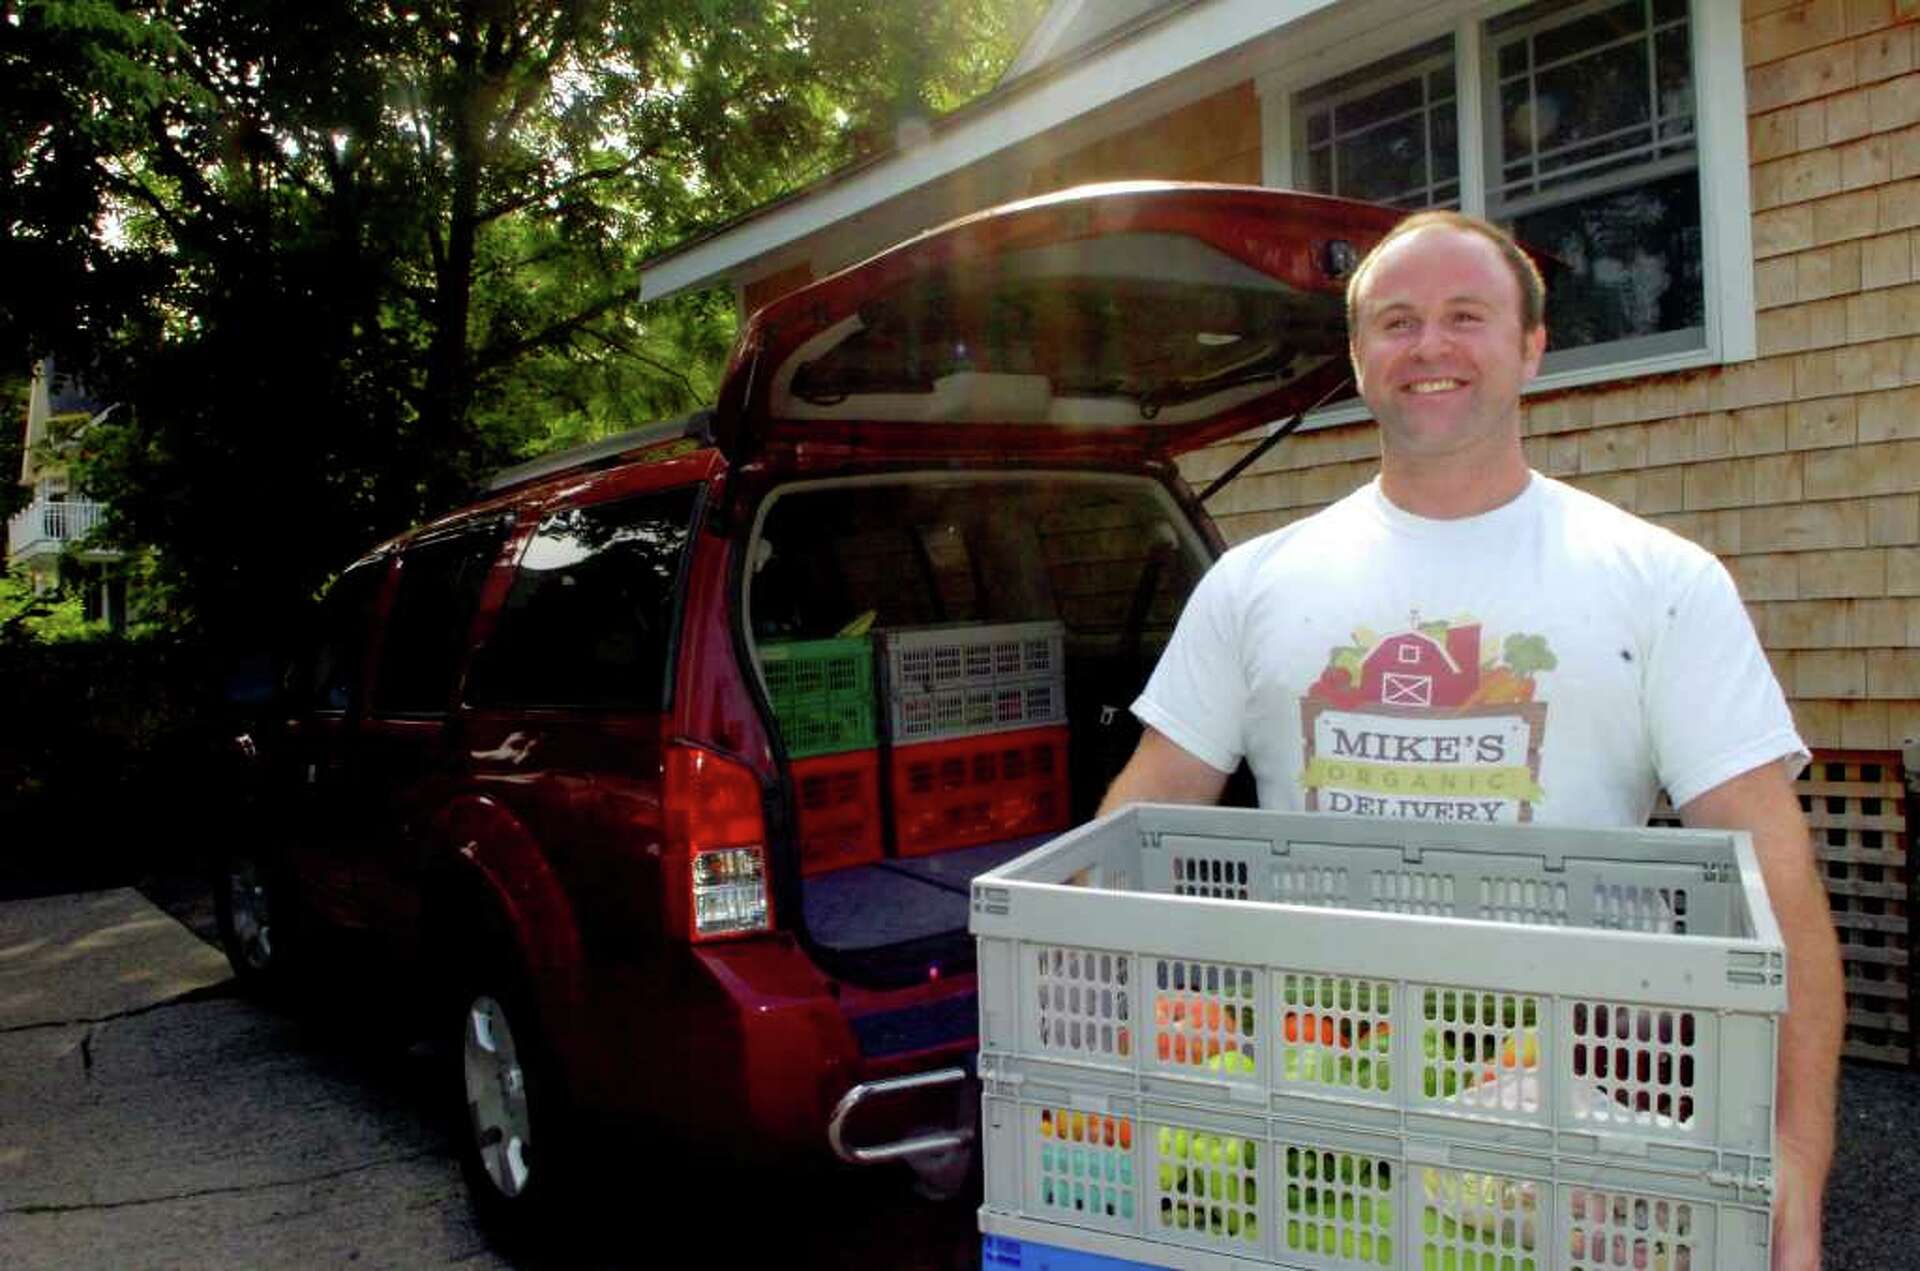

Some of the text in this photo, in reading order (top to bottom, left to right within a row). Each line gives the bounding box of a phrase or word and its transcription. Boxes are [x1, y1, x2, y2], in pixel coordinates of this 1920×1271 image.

[1331, 727, 1504, 763] MIKE'S
[1327, 764, 1504, 791] ORGANIC
[1329, 791, 1504, 822] DELIVERY
